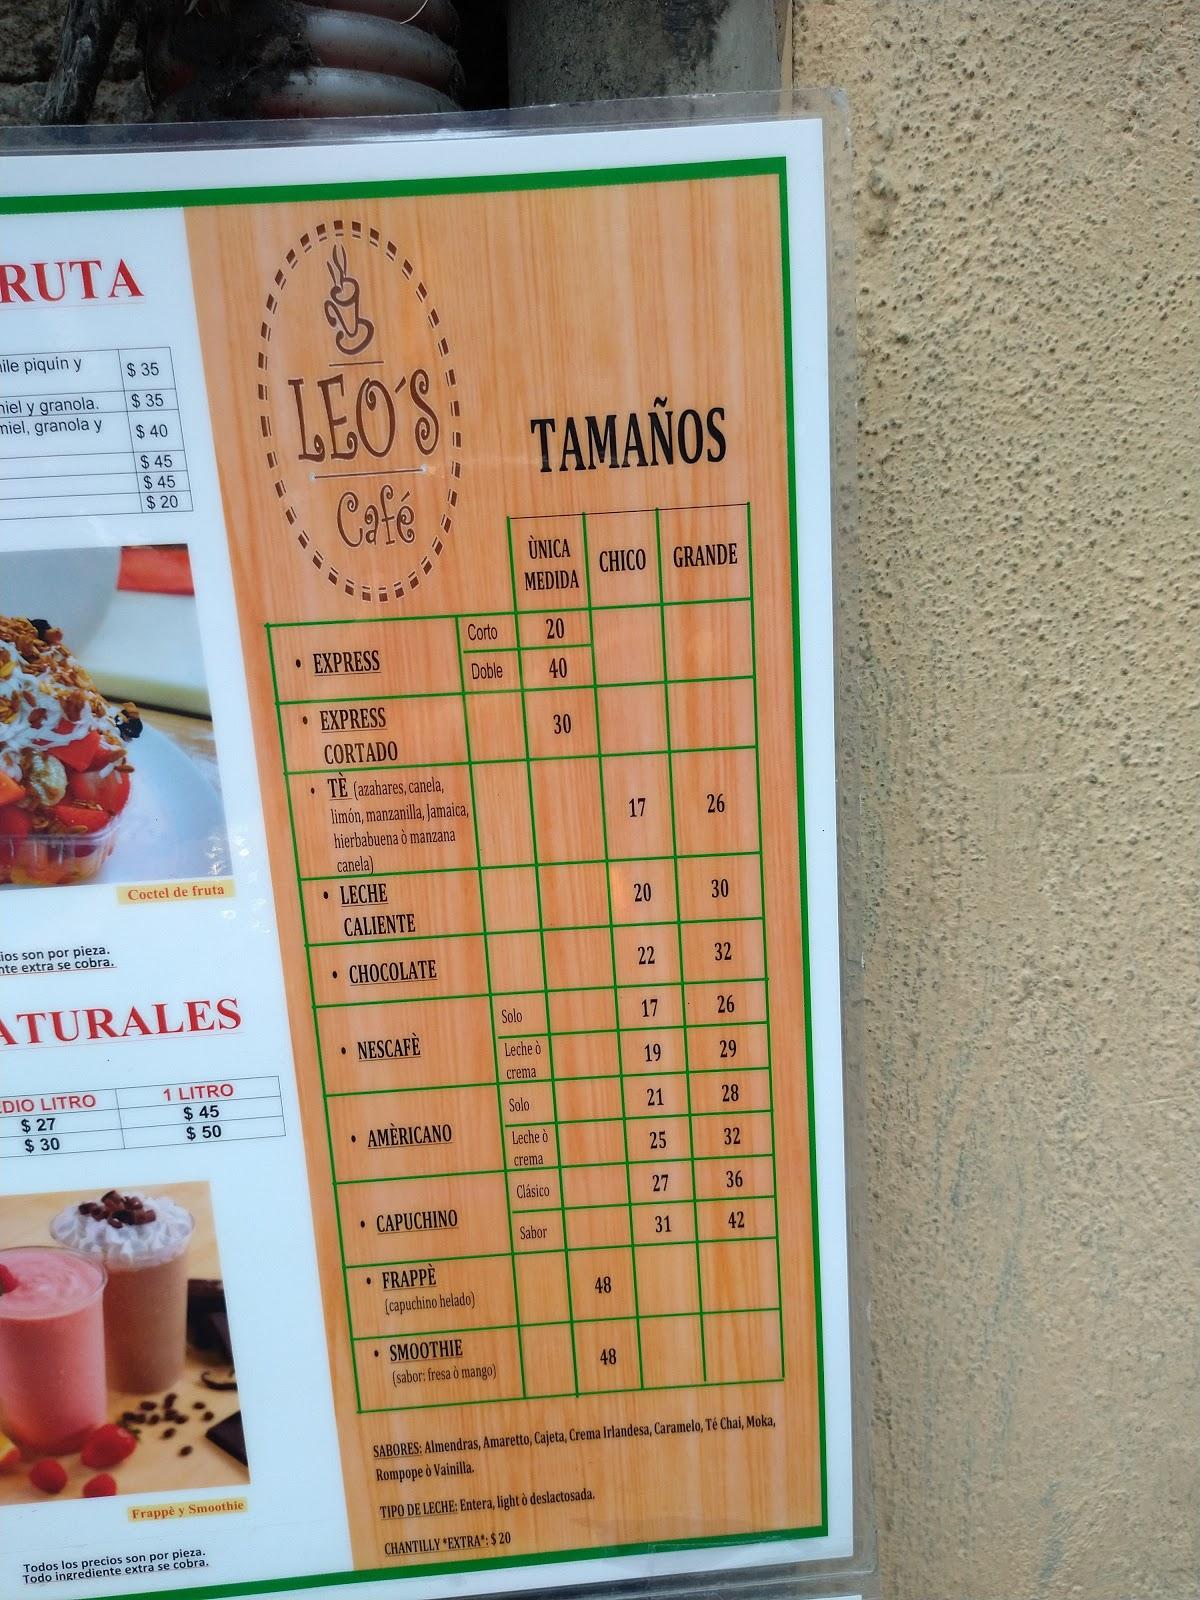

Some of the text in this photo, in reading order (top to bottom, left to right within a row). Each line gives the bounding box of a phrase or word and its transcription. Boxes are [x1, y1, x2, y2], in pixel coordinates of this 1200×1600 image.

[73, 358, 81, 372] y
[126, 362, 160, 377] $ 35
[27, 402, 34, 416] y
[39, 397, 99, 415] granola.
[131, 393, 164, 408] $ 35
[35, 418, 89, 436] granola
[94, 420, 102, 433] y
[136, 424, 168, 439] $ 40
[530, 396, 727, 473] TAMAÑOS
[140, 454, 173, 469] $ 45
[143, 475, 176, 490] $ 45
[147, 495, 178, 510] $ 20
[336, 485, 415, 548] Café
[599, 548, 646, 573] CHICO
[673, 542, 738, 568] GRANDE
[524, 569, 579, 592] MEDIDA
[467, 623, 498, 641] Corto
[545, 618, 564, 639] 20
[313, 650, 380, 674] EXPRESS
[471, 663, 503, 680] Doble
[549, 657, 568, 679] 40
[320, 707, 386, 731] EXPRESS
[553, 713, 572, 735] 30
[324, 741, 398, 765] CORTADO
[327, 772, 444, 800] TÈ (azahares, canela,
[330, 802, 469, 825] limón, manzanilla, Jamaica,
[629, 797, 646, 819] 17
[707, 793, 725, 814] 26
[334, 831, 398, 849] hierbabuena
[410, 830, 456, 845] manzana
[336, 855, 374, 874] canela)
[127, 884, 224, 901] Coctel de fruta
[340, 883, 388, 905] LECHE
[633, 882, 652, 903] 20
[711, 878, 729, 899] 30
[344, 913, 416, 937] CALIENTE
[22, 951, 44, 960] son
[48, 949, 69, 961] por
[74, 946, 110, 959] pieza.
[637, 946, 656, 966] 22
[714, 942, 732, 962] 32
[22, 962, 54, 972] extra
[58, 961, 71, 970] se
[75, 958, 114, 969] cobra.
[349, 959, 437, 984] CHOCOLATE
[641, 998, 659, 1019] 17
[717, 994, 735, 1014] 26
[501, 1008, 523, 1024] Solo
[357, 1033, 421, 1060] NESCAFÈ
[504, 1041, 533, 1057] Leche
[644, 1043, 662, 1063] 19
[719, 1039, 738, 1059] 29
[506, 1065, 537, 1080] crema
[163, 1083, 234, 1102] 1 LITRO
[646, 1088, 664, 1107] 21
[721, 1083, 739, 1103] 28
[0, 1094, 96, 1114] DIO LITRO
[183, 1104, 220, 1121] $ 45
[509, 1097, 530, 1113] Solo
[21, 1117, 56, 1134] $ 27
[186, 1125, 222, 1141] $ 50
[24, 1137, 60, 1154] $ 30
[512, 1130, 540, 1145] Leche
[649, 1130, 667, 1150] 25
[723, 1126, 741, 1146] 32
[514, 1153, 543, 1166] crema
[652, 1174, 669, 1193] 27
[726, 1169, 744, 1189] 36
[516, 1184, 550, 1199] Clásico
[376, 1209, 458, 1233] CAPUCHINO
[655, 1215, 672, 1234] 31
[728, 1211, 745, 1230] 42
[520, 1225, 548, 1240] Sabor
[594, 1275, 612, 1295] 48
[385, 1291, 476, 1315] (capuchino helado)
[390, 1339, 463, 1362] SMOOTHIE
[599, 1347, 617, 1367] 48
[392, 1369, 426, 1387] (sabor:
[427, 1367, 451, 1382] fresa
[461, 1363, 497, 1382] mango)
[373, 1414, 776, 1458] SABORES: Almendras, Amaretto, Cajeta, Crema Irlandesa, Caramelo, Té Chai, Moka,
[376, 1465, 423, 1483] Rompope
[434, 1461, 475, 1477] Vainilla.
[178, 1507, 187, 1518] y
[188, 1500, 245, 1515] Smoothie
[380, 1502, 405, 1519] TIPO
[407, 1501, 421, 1516] DE
[423, 1500, 458, 1515] LECHE:
[460, 1498, 495, 1513] Entera,
[497, 1495, 519, 1511] light
[530, 1488, 595, 1505] deslactosada.
[384, 1538, 441, 1556] CHANTILLY
[490, 1532, 497, 1546] $
[499, 1531, 511, 1545] 20
[23, 1549, 206, 1573] Todos los precios son por pieza.
[22, 1559, 209, 1584] Todo ingrediente extra se cobra.
